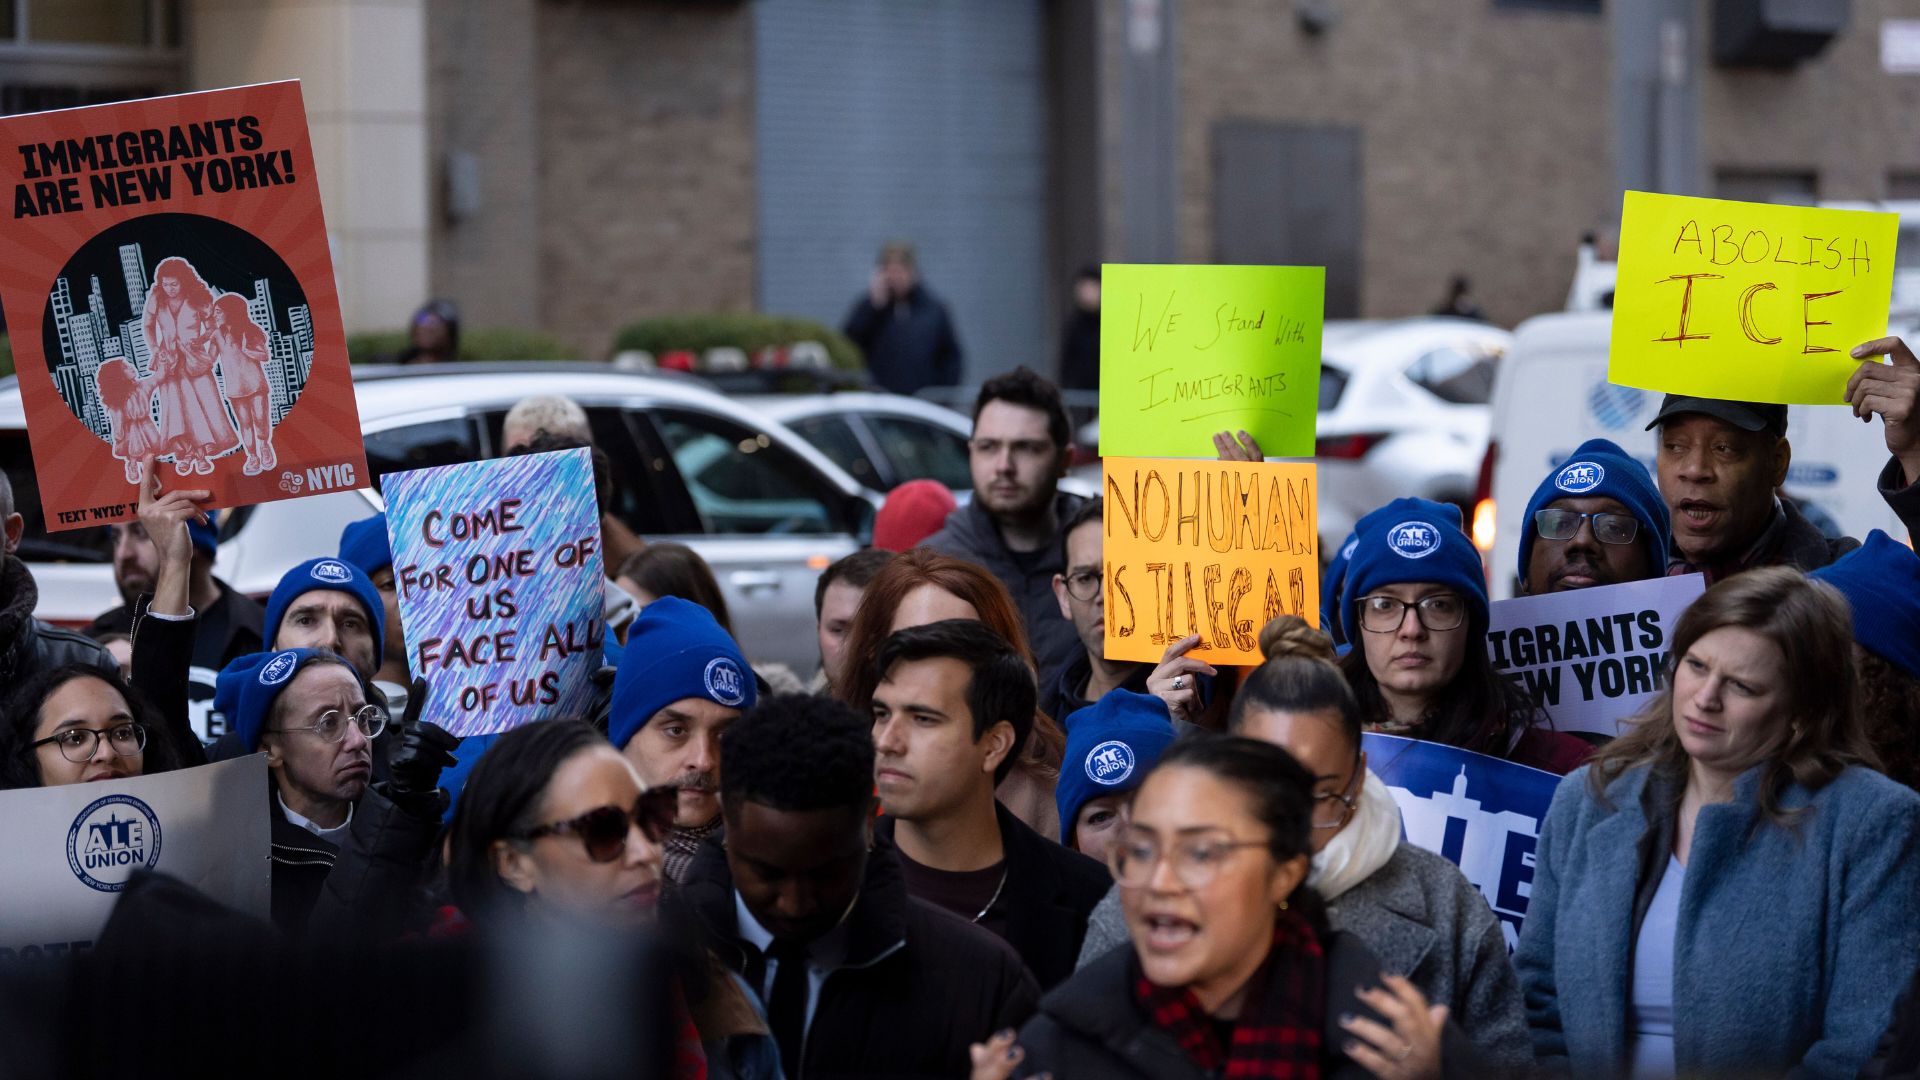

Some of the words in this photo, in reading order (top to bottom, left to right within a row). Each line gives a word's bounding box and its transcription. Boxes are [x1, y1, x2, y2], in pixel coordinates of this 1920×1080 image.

[18, 115, 263, 179] IMMIGRANTS
[14, 177, 83, 219] ARE
[89, 165, 172, 209] NEW
[181, 149, 296, 196] YORK!
[1673, 219, 1871, 277] ABOLISH
[1132, 290, 1182, 352] WE
[1194, 302, 1265, 350] Stand
[1651, 273, 1846, 354] ICE
[1139, 367, 1287, 411] IMMIGRANTS
[306, 463, 355, 492] NYIC
[1563, 476, 1594, 486] UNION
[1567, 467, 1594, 478] ALE
[57, 509, 87, 524] TEXT
[422, 499, 524, 547] COME
[1400, 528, 1431, 540] ALE
[1397, 538, 1430, 548] UNION
[400, 563, 455, 599] FOR
[466, 550, 535, 586] ONE
[554, 536, 595, 568] OF
[1107, 561, 1136, 638] IS
[418, 630, 516, 675] FACE
[539, 618, 602, 662] ALL
[1487, 609, 1664, 670] IGRANTS
[460, 683, 498, 712] OF
[1095, 748, 1122, 768] ALE
[1096, 758, 1127, 777] UNION
[84, 821, 143, 854] ALE
[85, 848, 144, 869] UNION
